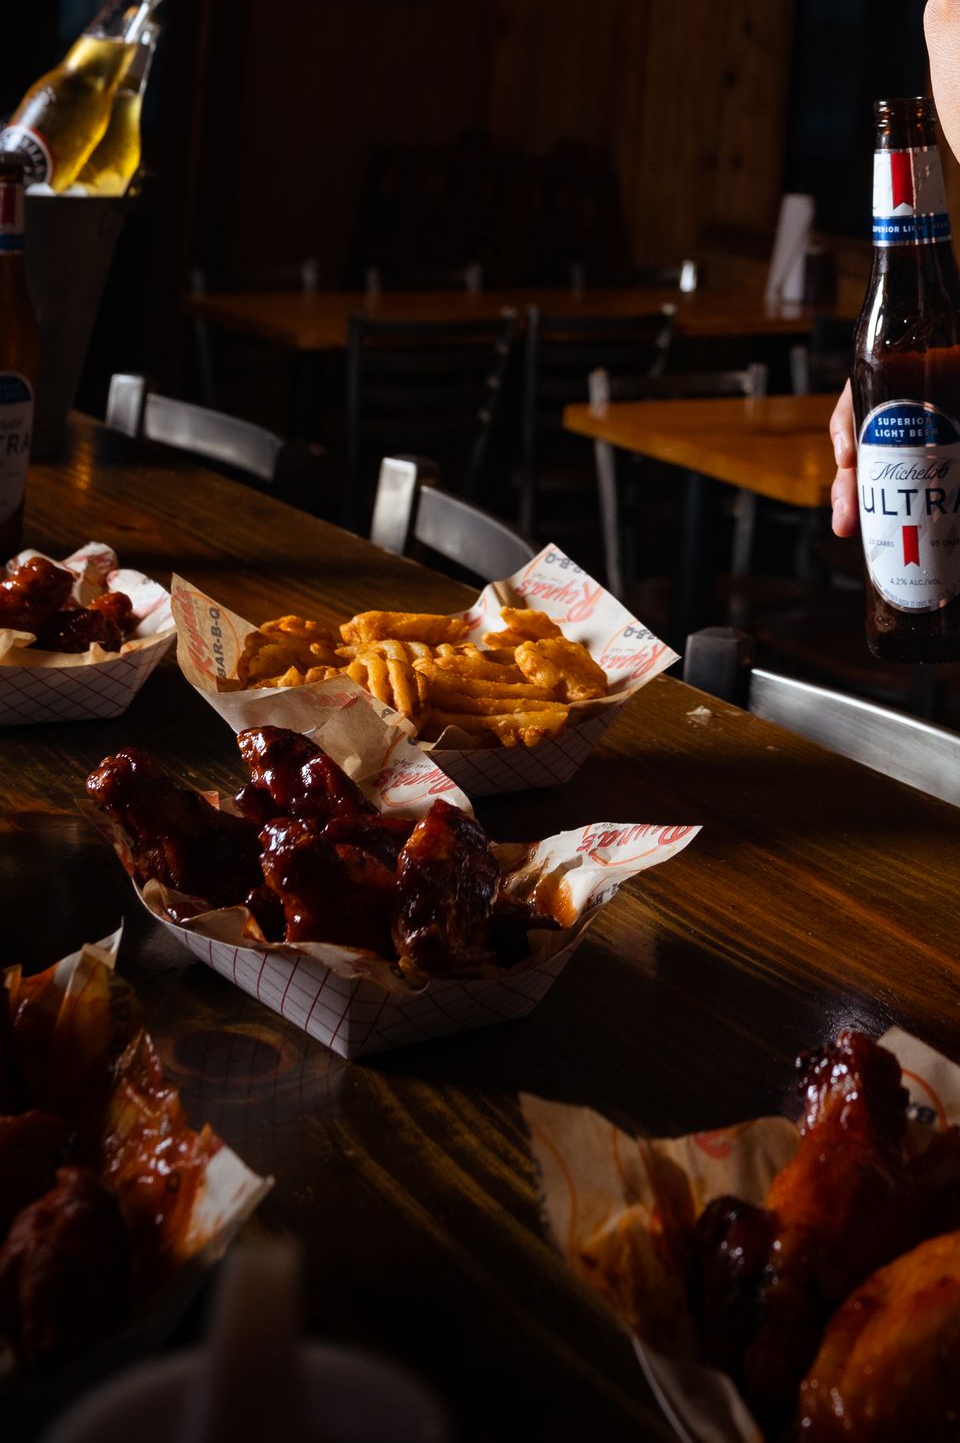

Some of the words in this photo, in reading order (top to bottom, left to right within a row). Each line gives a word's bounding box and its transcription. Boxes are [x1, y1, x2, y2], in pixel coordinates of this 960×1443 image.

[877, 416, 933, 427] SUPERIOR
[874, 428, 905, 439] LIGHT
[909, 428, 939, 438] BEER
[870, 460, 951, 481] Michelob
[209, 607, 227, 679] BAR-B-Q
